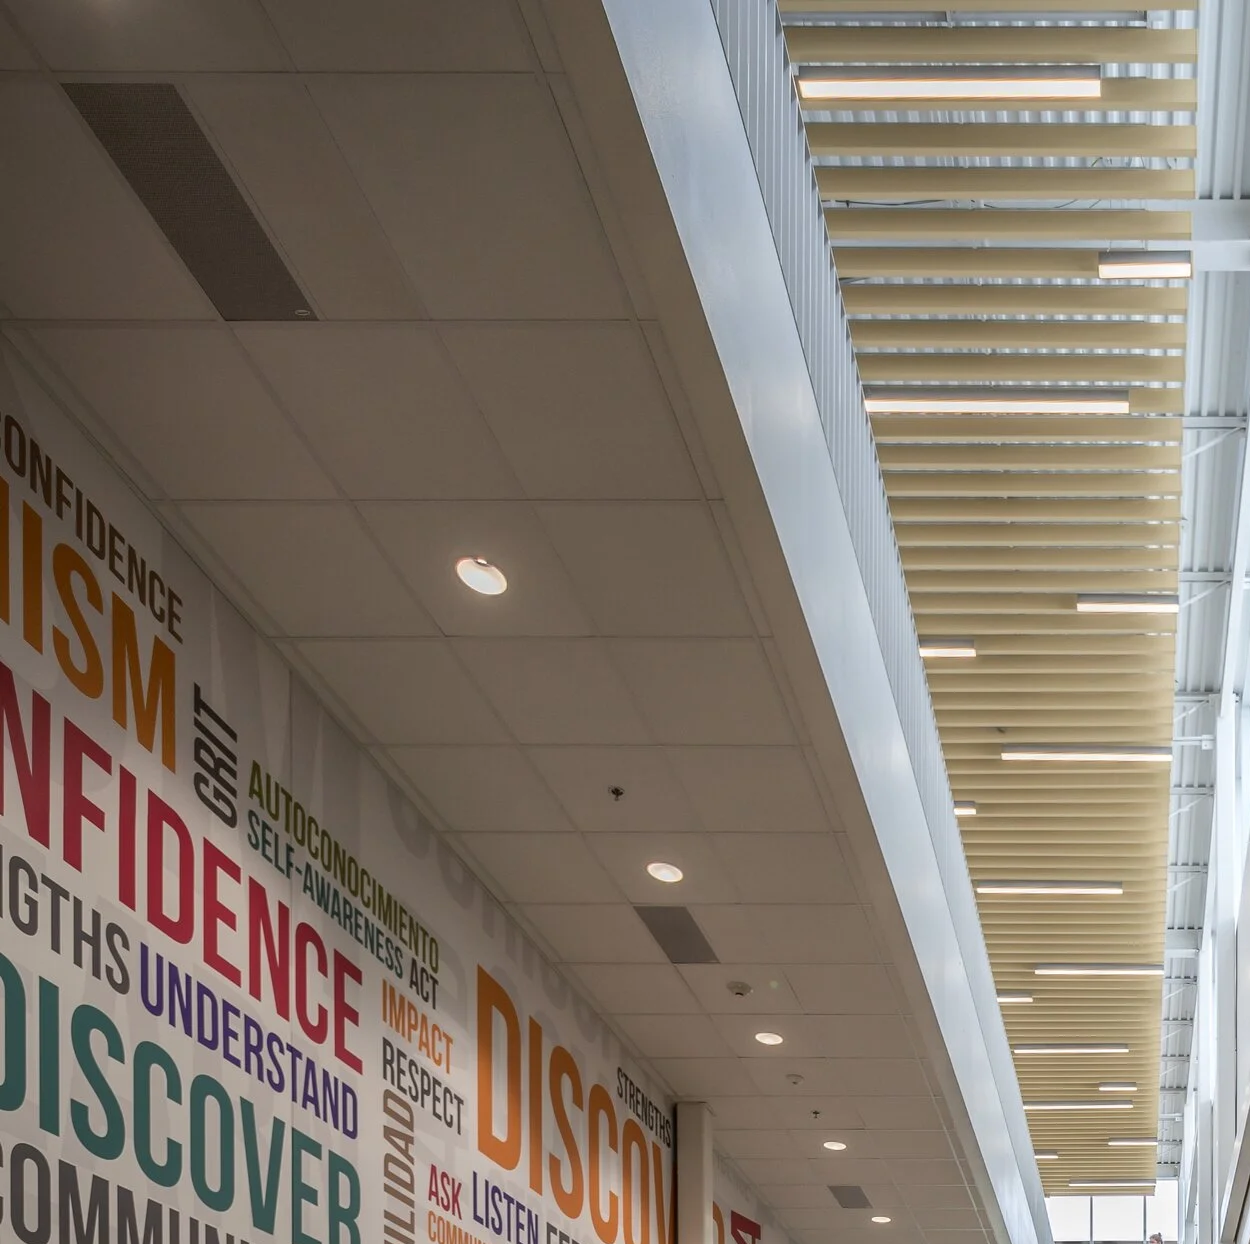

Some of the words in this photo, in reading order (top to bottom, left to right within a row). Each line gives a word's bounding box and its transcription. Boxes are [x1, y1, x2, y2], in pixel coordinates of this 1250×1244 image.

[0, 412, 183, 644] ONFIDENCE
[194, 682, 237, 828] GRIT
[0, 845, 130, 995] GTHS
[248, 809, 403, 979] SELF-AWARENESS
[249, 760, 439, 974] AUTOCONOCIMIENTO
[140, 941, 358, 1139] UNDERSTAND
[382, 979, 453, 1074] IMPACT
[409, 957, 439, 1010] ACT
[382, 1036, 464, 1135] RESPECT
[616, 1066, 671, 1148] STRENGTHS
[428, 1163, 462, 1220] ASK
